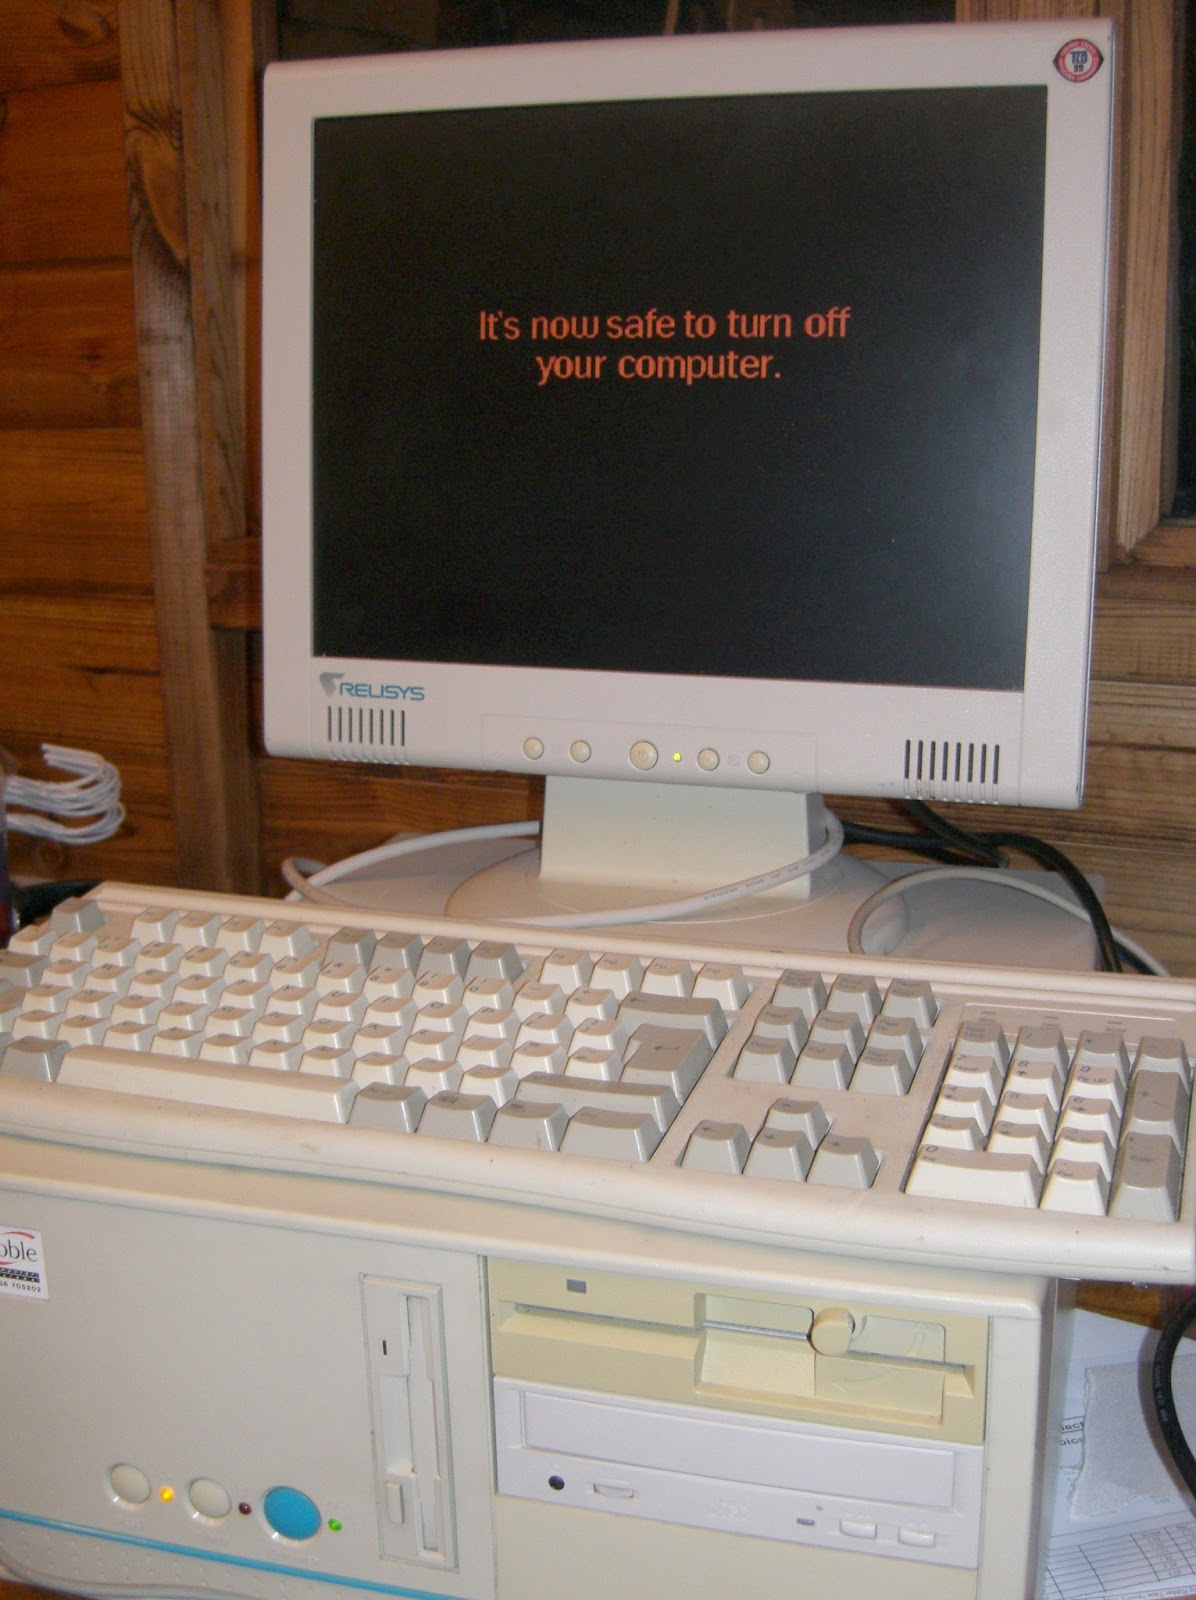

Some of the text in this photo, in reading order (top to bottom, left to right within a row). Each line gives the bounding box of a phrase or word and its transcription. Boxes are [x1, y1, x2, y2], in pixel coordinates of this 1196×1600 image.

[479, 306, 851, 341] It's now safe to turn off
[535, 350, 781, 386] your computer.
[339, 682, 425, 701] RELISYS
